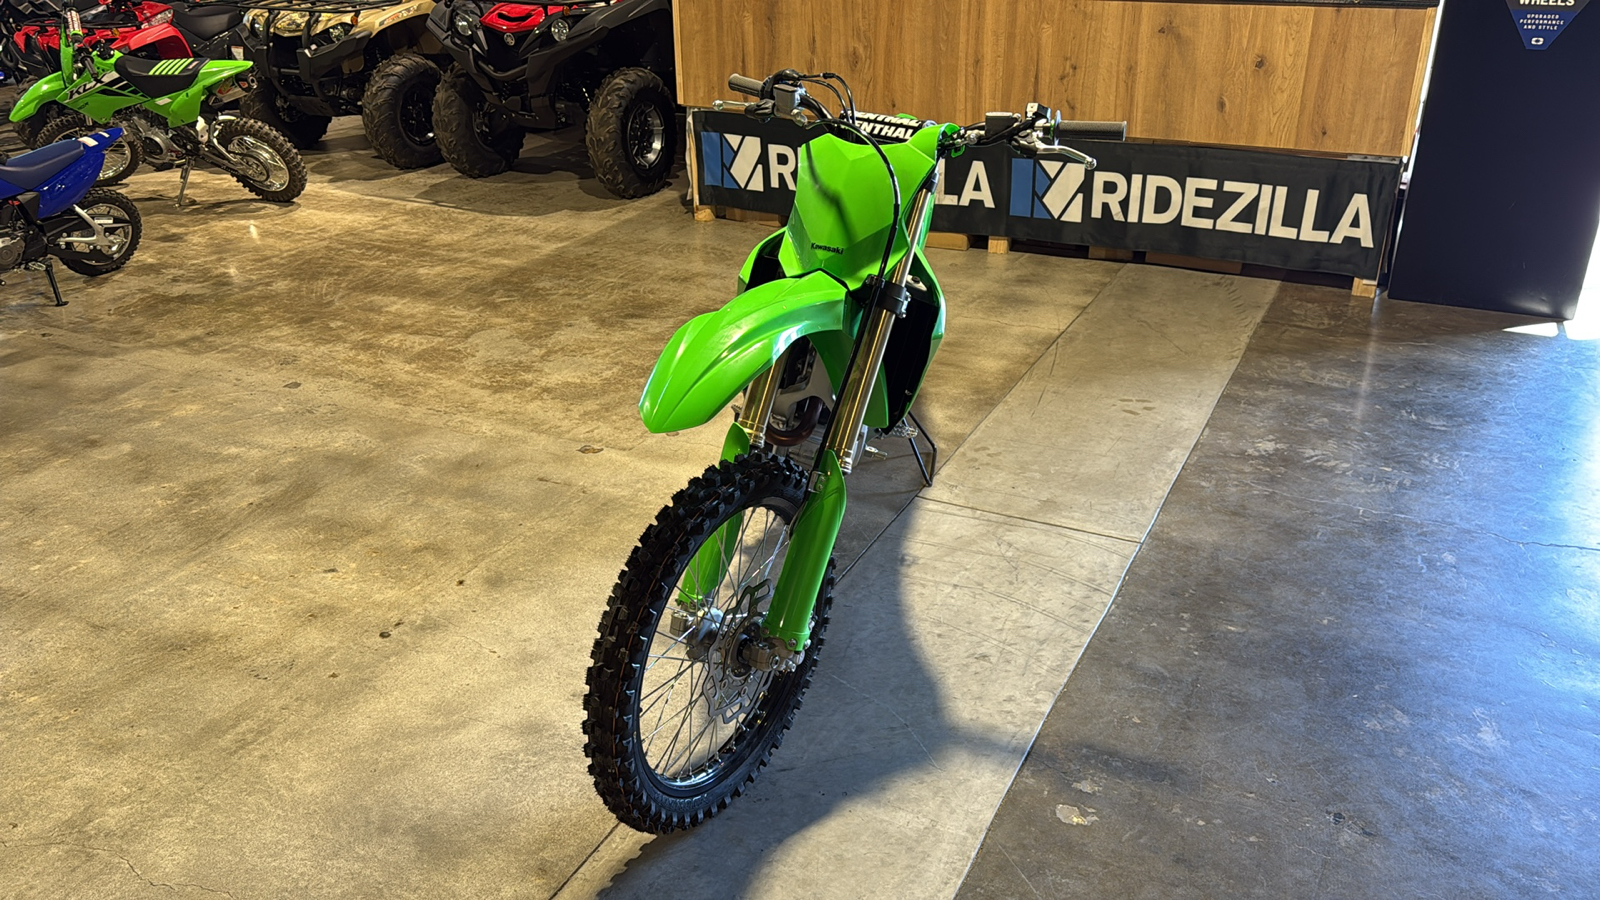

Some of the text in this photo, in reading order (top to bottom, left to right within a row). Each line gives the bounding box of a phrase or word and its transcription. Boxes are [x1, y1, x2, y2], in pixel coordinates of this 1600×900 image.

[852, 119, 915, 140] ENTHAL
[1091, 170, 1374, 249] RIDEZILLA
[810, 242, 844, 255] Kawasaki
